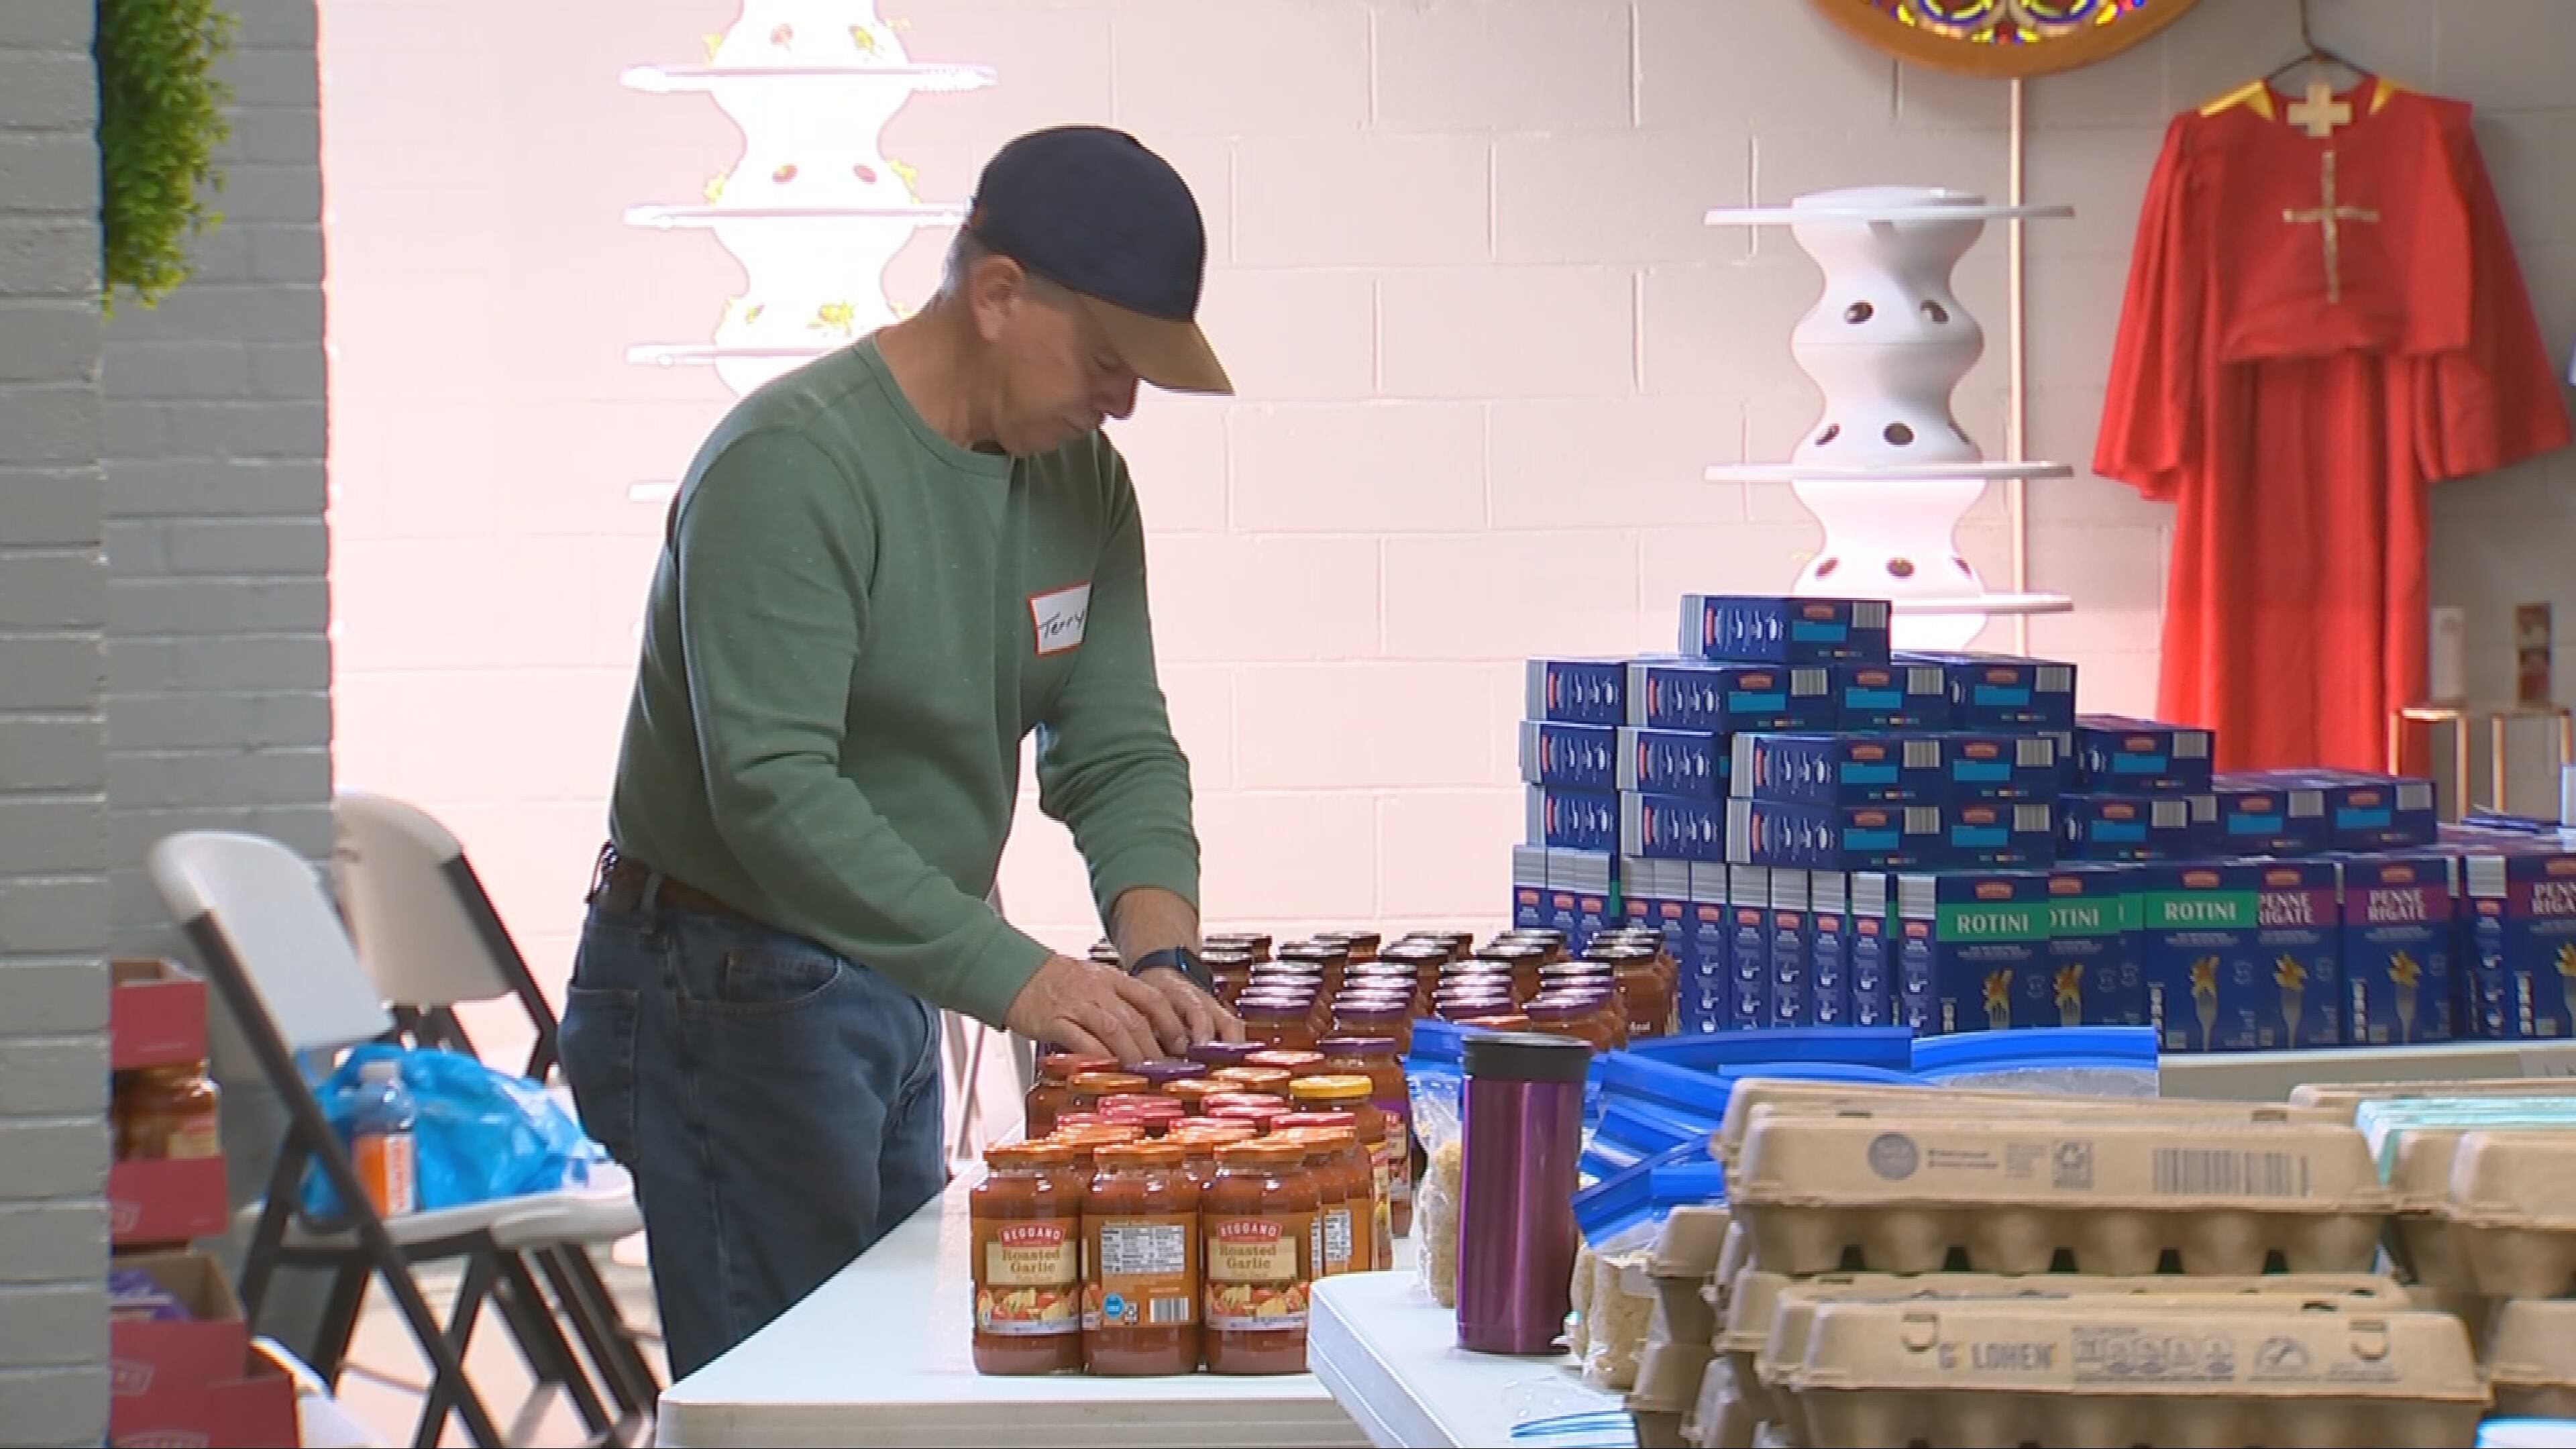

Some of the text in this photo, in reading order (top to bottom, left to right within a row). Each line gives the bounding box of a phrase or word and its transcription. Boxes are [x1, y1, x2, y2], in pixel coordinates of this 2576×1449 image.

[1038, 608, 1086, 638] Terry
[2369, 890, 2423, 905] PENNE
[2533, 882, 2576, 898] PENN
[2164, 901, 2236, 920] ROTINI
[2367, 906, 2427, 922] RIGATE
[1957, 914, 2029, 934] ROTINI
[1002, 1226, 1061, 1242] REGGANO
[1221, 1223, 1277, 1237] REGGANO
[1002, 1249, 1061, 1260] Roasted
[1220, 1244, 1277, 1256] Roasted
[1010, 1262, 1057, 1273] Garlic
[1227, 1257, 1272, 1269] Garlic
